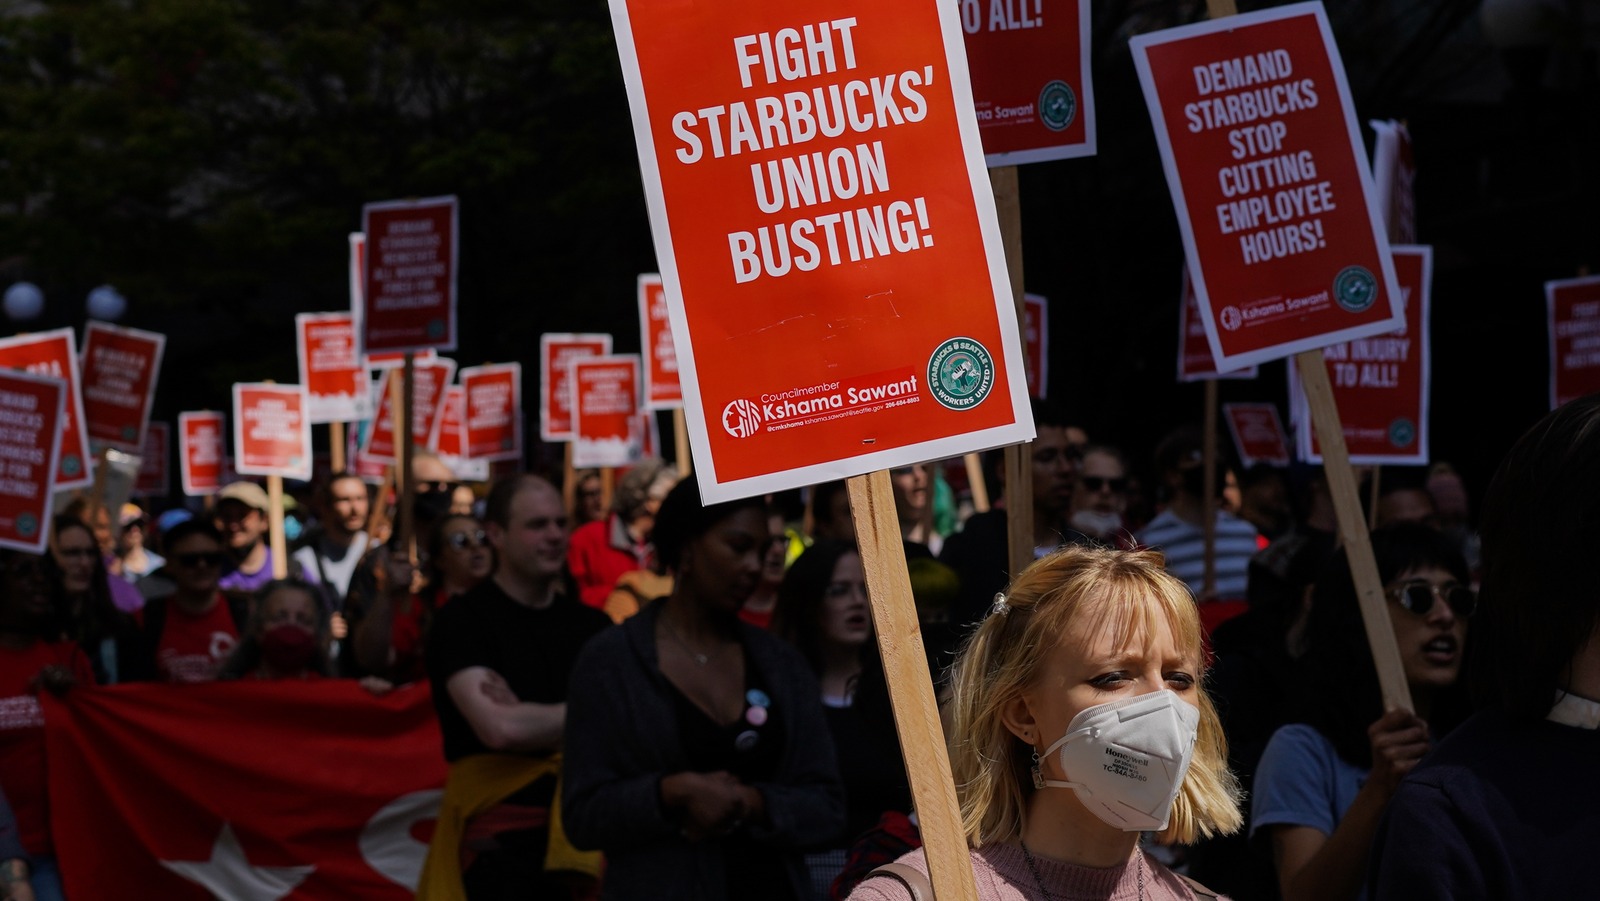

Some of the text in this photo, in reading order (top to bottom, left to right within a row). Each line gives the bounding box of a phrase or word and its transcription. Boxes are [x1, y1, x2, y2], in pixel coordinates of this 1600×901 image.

[958, 0, 981, 34] O
[733, 17, 858, 88] FIGHT
[1193, 49, 1293, 95] DEMAND
[1184, 78, 1319, 133] STARBUCKS
[1228, 121, 1288, 160] STOP
[750, 140, 890, 214] UNION
[1218, 150, 1317, 198] CUTTING
[1216, 181, 1336, 234] EMPLOYEE
[728, 197, 935, 284] BUSTING!
[1239, 219, 1327, 265] HOURS!
[931, 345, 954, 388] STARBUCKS
[960, 342, 988, 364] SEATTLE
[938, 369, 990, 405] WORKERS UNITED
[1334, 363, 1399, 388] TO ALL!
[761, 381, 840, 403] Councilmember
[762, 375, 917, 421] Kshama Sawant
[767, 421, 804, 432] @cmkshama
[1105, 747, 1149, 766] Honeywell
